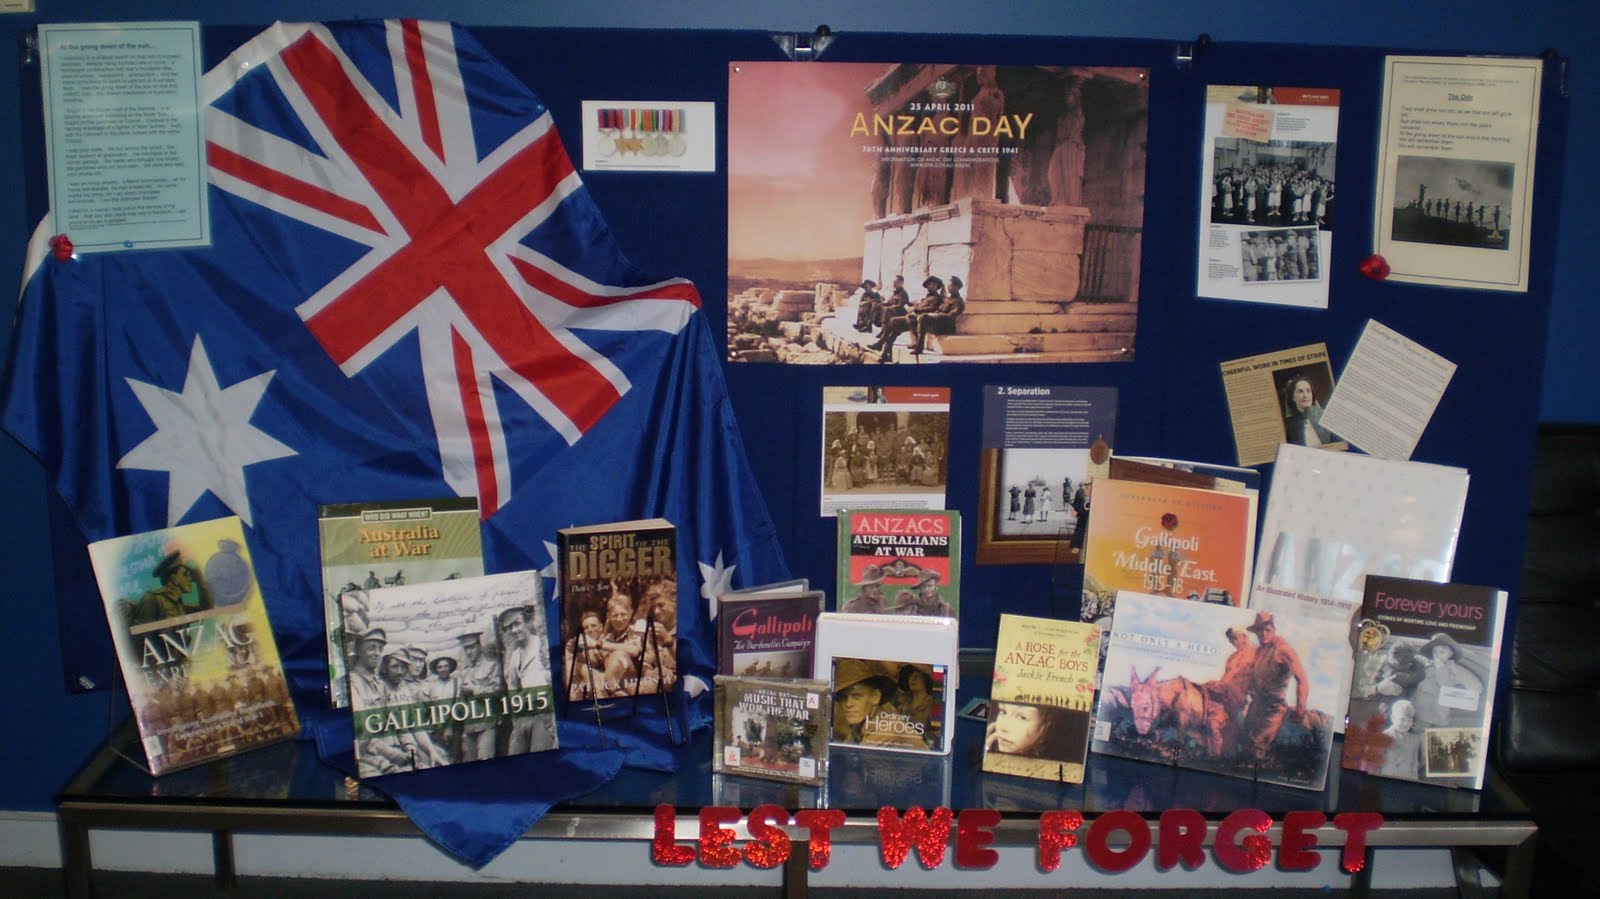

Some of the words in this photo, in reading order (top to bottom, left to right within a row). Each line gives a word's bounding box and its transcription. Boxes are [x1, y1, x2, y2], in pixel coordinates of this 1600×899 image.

[910, 103, 921, 111] 25
[925, 103, 950, 111] APRIL
[954, 103, 975, 111] 2011
[850, 112, 959, 138] ANZAC
[972, 113, 1033, 140] DAY
[1223, 366, 1252, 376] CHEERFUL
[1279, 357, 1297, 365] TIMES
[997, 387, 1006, 396] 2.
[1007, 386, 1050, 399] Separation
[391, 511, 407, 519] WHAT
[360, 525, 440, 543] Australia
[857, 517, 945, 534] ANZACS
[590, 534, 636, 550] SPIRIT
[853, 534, 948, 546] AUSTRALIANS
[1135, 527, 1200, 552] Gallipoli
[369, 543, 387, 558] at
[394, 541, 431, 557] War
[874, 546, 892, 556] AT
[895, 546, 925, 557] WAR
[569, 546, 671, 581] DIGGER
[1112, 551, 1172, 576] Middle
[1178, 560, 1218, 583] East
[1265, 586, 1296, 599] Illustrated
[1297, 593, 1319, 605] History
[1375, 592, 1435, 614] Forever
[1438, 602, 1484, 620] yours
[732, 608, 812, 640] Gallipoli
[1015, 641, 1022, 651] A
[1025, 641, 1056, 655] ROSE
[1112, 631, 1135, 641] NOT
[1188, 644, 1218, 654] HERO
[1004, 652, 1056, 669] ANZAC
[1059, 658, 1089, 672] BOYS
[1017, 668, 1043, 680] Jackie
[1046, 671, 1074, 683] French
[743, 693, 777, 706] MUSIC
[780, 697, 806, 710] THAT
[365, 698, 493, 734] GALLIPOLI
[500, 691, 549, 715] 1915
[739, 702, 763, 714] WON
[767, 706, 785, 717] THE
[786, 708, 809, 721] WAR
[880, 711, 911, 722] Ordinary
[865, 714, 925, 735] Heroes
[653, 803, 847, 870] LEST
[877, 805, 1002, 870] WE
[1039, 809, 1385, 872] FORGET
